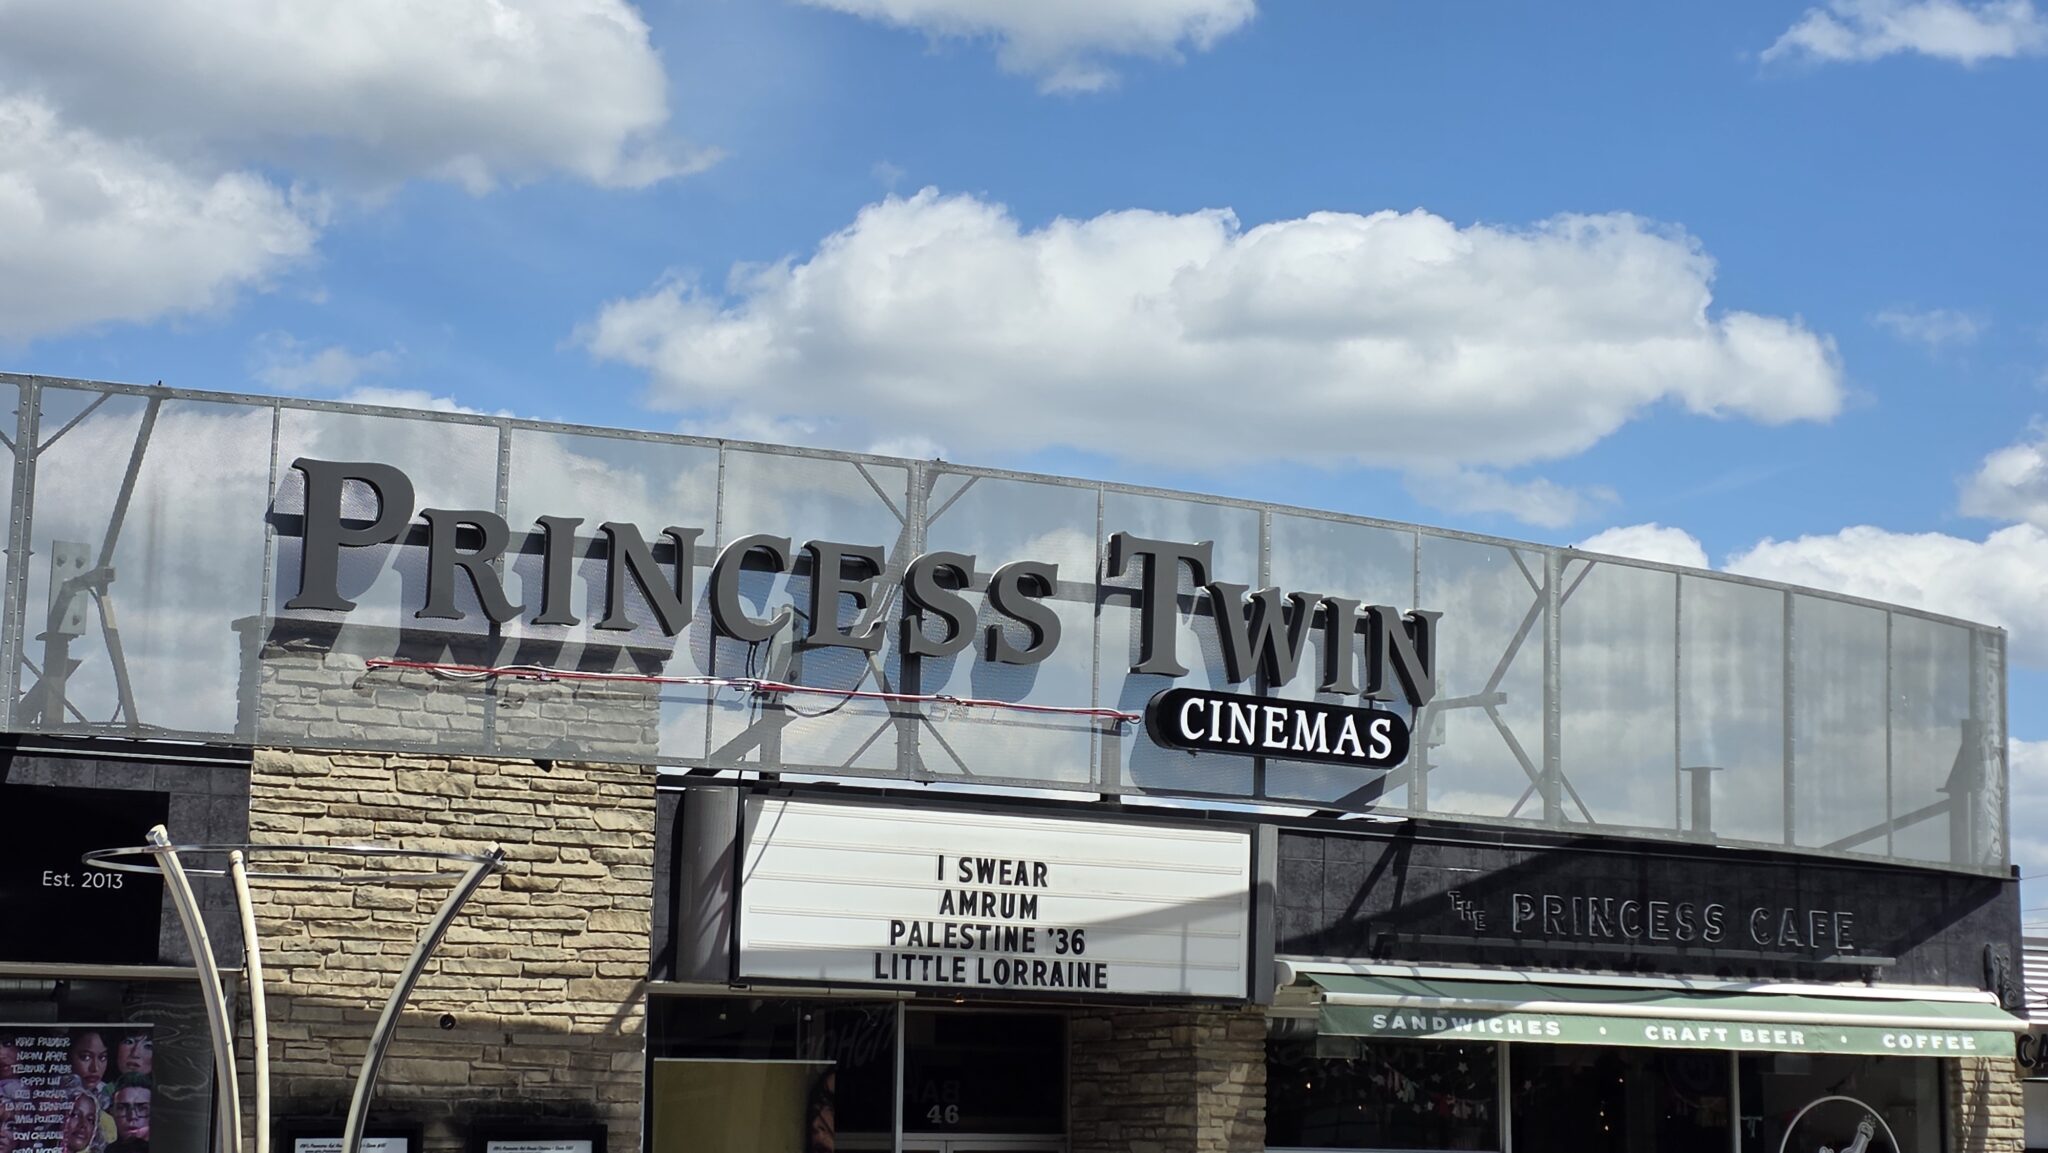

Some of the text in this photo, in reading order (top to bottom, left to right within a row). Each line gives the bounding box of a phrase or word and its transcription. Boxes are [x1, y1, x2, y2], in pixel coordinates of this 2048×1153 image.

[283, 456, 1444, 708] PRINCESS TWIN
[1179, 697, 1392, 761] CINEMAS
[42, 870, 124, 889] Est. 2013
[937, 854, 1048, 887] I SWEAR
[939, 889, 1038, 920] AMRUM
[1447, 890, 1486, 931] THE
[1512, 893, 1855, 950] PRINCESS CAFE
[889, 919, 1086, 956] PALESTINE '36
[875, 952, 1108, 989] LITTLE LORRAINE
[1372, 1013, 1977, 1051] SANDWICHES CRAFT BEER COFFEE
[20, 1076, 45, 1087] POPPY
[926, 1104, 960, 1125] 46
